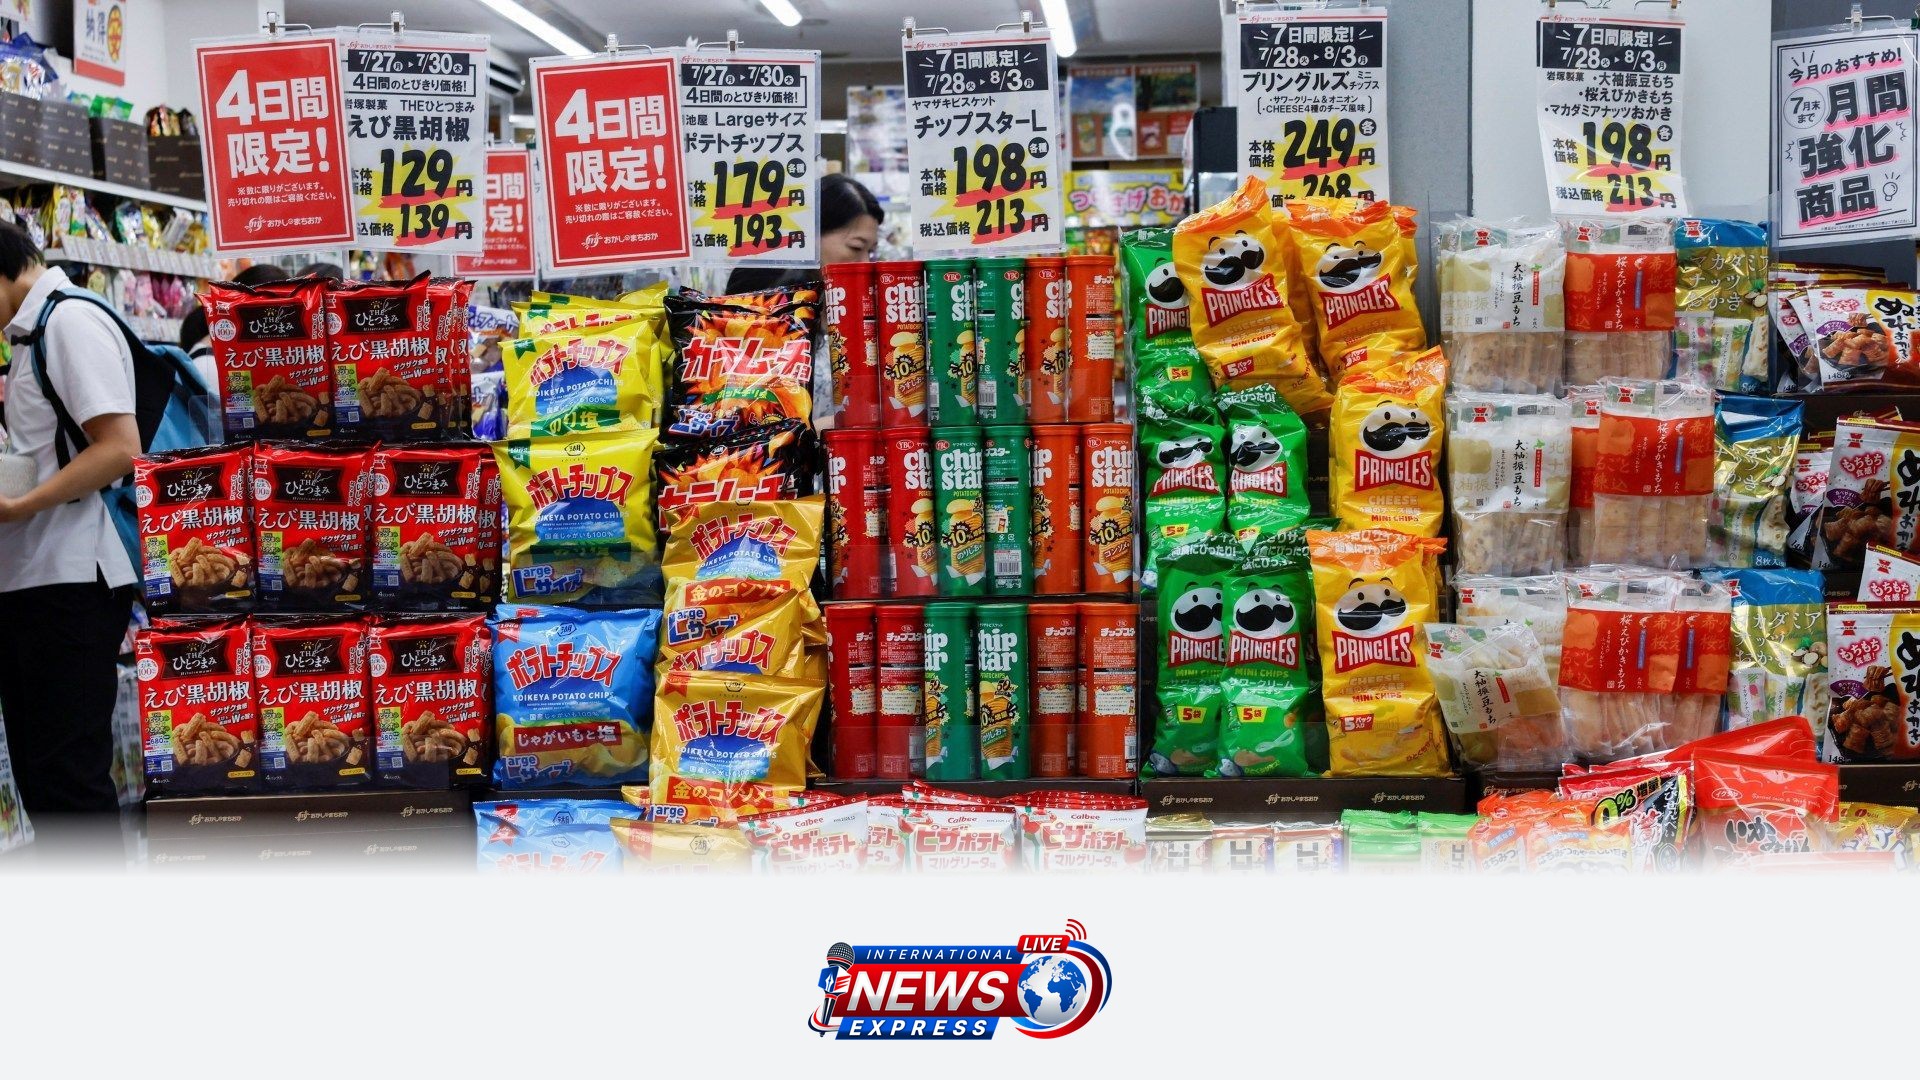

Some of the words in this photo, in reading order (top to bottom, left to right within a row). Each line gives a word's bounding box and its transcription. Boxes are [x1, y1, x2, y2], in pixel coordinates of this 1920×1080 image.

[1271, 23, 1354, 45] 7日間限定!
[1573, 23, 1654, 48] 7日間限定!
[936, 49, 1019, 72] 7日間限定!
[1788, 47, 1902, 83] 今月のおすすめ!
[352, 73, 467, 93] 4日間のとびきり価格!
[1243, 70, 1351, 93] プリングルズ
[1350, 80, 1380, 91] チップス
[1357, 70, 1372, 80] ミニ
[1546, 70, 1585, 82] 岩塚製菓
[215, 69, 329, 126] 4日間
[685, 85, 799, 104] 4日間のとびきり価格!
[912, 95, 996, 110] ヤマザキビスケット
[1826, 71, 1908, 125] 月間
[400, 100, 475, 114] THEひとつまみ
[554, 88, 668, 144] 4日間
[1797, 113, 1815, 124] まで
[348, 114, 471, 142] えび黒胡椒
[682, 113, 708, 127] 池屋
[715, 112, 807, 128] Largeサイズ
[914, 109, 1047, 140] チップスターL
[227, 128, 331, 179] 限定!
[685, 132, 806, 154] ポテトチップス
[1249, 139, 1275, 154] 本体
[1553, 138, 1577, 151] 本体
[1799, 124, 1895, 178] 強化
[1248, 154, 1275, 168] 価格
[1554, 151, 1579, 164] 価格
[566, 144, 667, 196] 限定!
[920, 168, 946, 182] 本体
[921, 182, 947, 197] 価格
[1556, 186, 1604, 202] 税込価格
[1797, 175, 1877, 223] 商品
[357, 222, 395, 237] 込価格
[485, 204, 525, 233] 定!
[920, 221, 970, 238] 税込価格
[693, 232, 729, 248] 込価格
[1691, 273, 1741, 291] ナッツ
[1206, 280, 1279, 322] PRINGLES
[1325, 278, 1395, 325] PRINGLES
[249, 319, 294, 334] ひとつまみ
[355, 312, 399, 328] ひとつまみ
[1252, 332, 1277, 343] CHIPS
[225, 344, 327, 369] えび黒胡椒
[332, 337, 432, 363] えび黒胡椒
[530, 338, 631, 386] ポテトチップス
[1359, 455, 1431, 487] PRINGLES
[1842, 453, 1884, 472] もちもち
[166, 483, 213, 498] ひとつまみ
[285, 481, 331, 497] ひとつまみ
[525, 463, 635, 512] ポテトチップス
[1153, 465, 1213, 493] PRINGLES
[1231, 466, 1284, 493] RINGLES
[1368, 495, 1418, 505] CHEESE
[141, 506, 245, 535] えび黒胡椒
[258, 507, 362, 532] えび黒胡椒
[375, 502, 478, 525] えび黒胡椒
[567, 512, 602, 521] POTATO
[690, 513, 798, 561] ポテトチップス
[1869, 579, 1910, 597] もちもち
[1231, 636, 1297, 666] PRINGLES
[1336, 631, 1412, 669] PRINGLES
[1838, 638, 1881, 661] もちもち
[505, 642, 622, 690] ポテトチップス
[144, 680, 252, 709] えび黒胡椒
[259, 680, 364, 705] えび黒胡椒
[512, 692, 550, 702] KOIKEYA
[552, 692, 586, 701] POTATO
[673, 700, 788, 746] ポテトチップス
[517, 725, 617, 748] じゃがいもと塩
[947, 815, 978, 824] Calbee
[1070, 813, 1101, 821] Calbee
[1663, 781, 1678, 836] えびせんべい
[794, 816, 825, 828] Calbee
[770, 829, 856, 863] ピザポテト
[915, 824, 1006, 854] ピザポテト
[1042, 822, 1131, 851] ピザポテト
